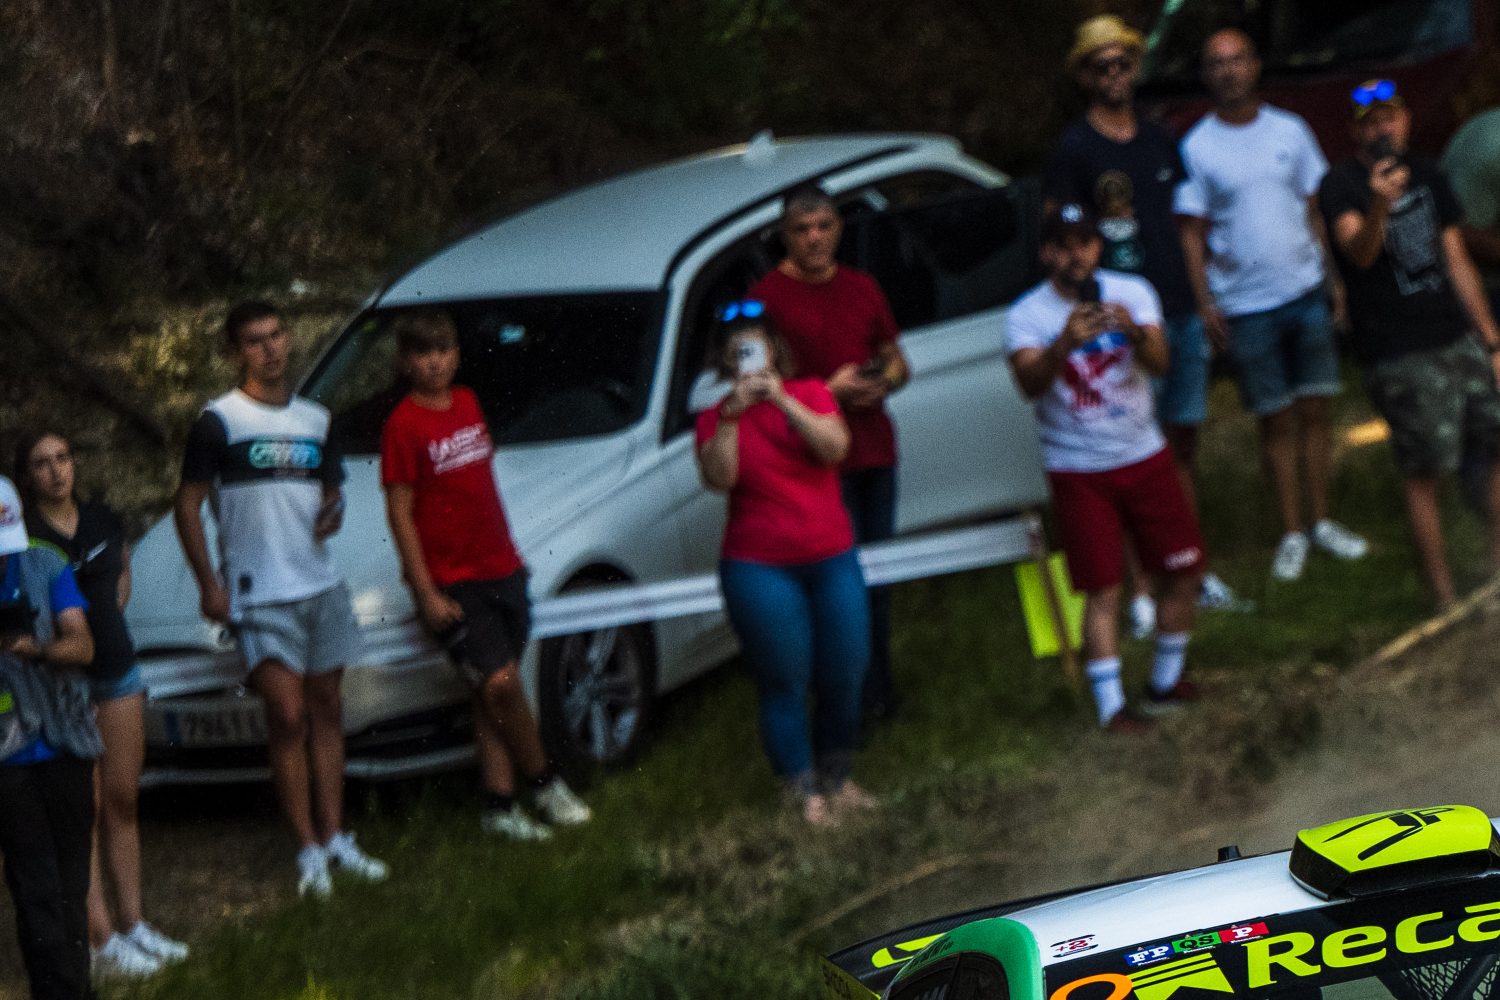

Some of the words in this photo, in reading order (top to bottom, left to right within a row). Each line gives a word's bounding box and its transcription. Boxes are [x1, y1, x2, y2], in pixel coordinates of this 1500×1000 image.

[1177, 933, 1214, 954] QS
[1232, 926, 1253, 940] P
[1128, 944, 1170, 966] FP
